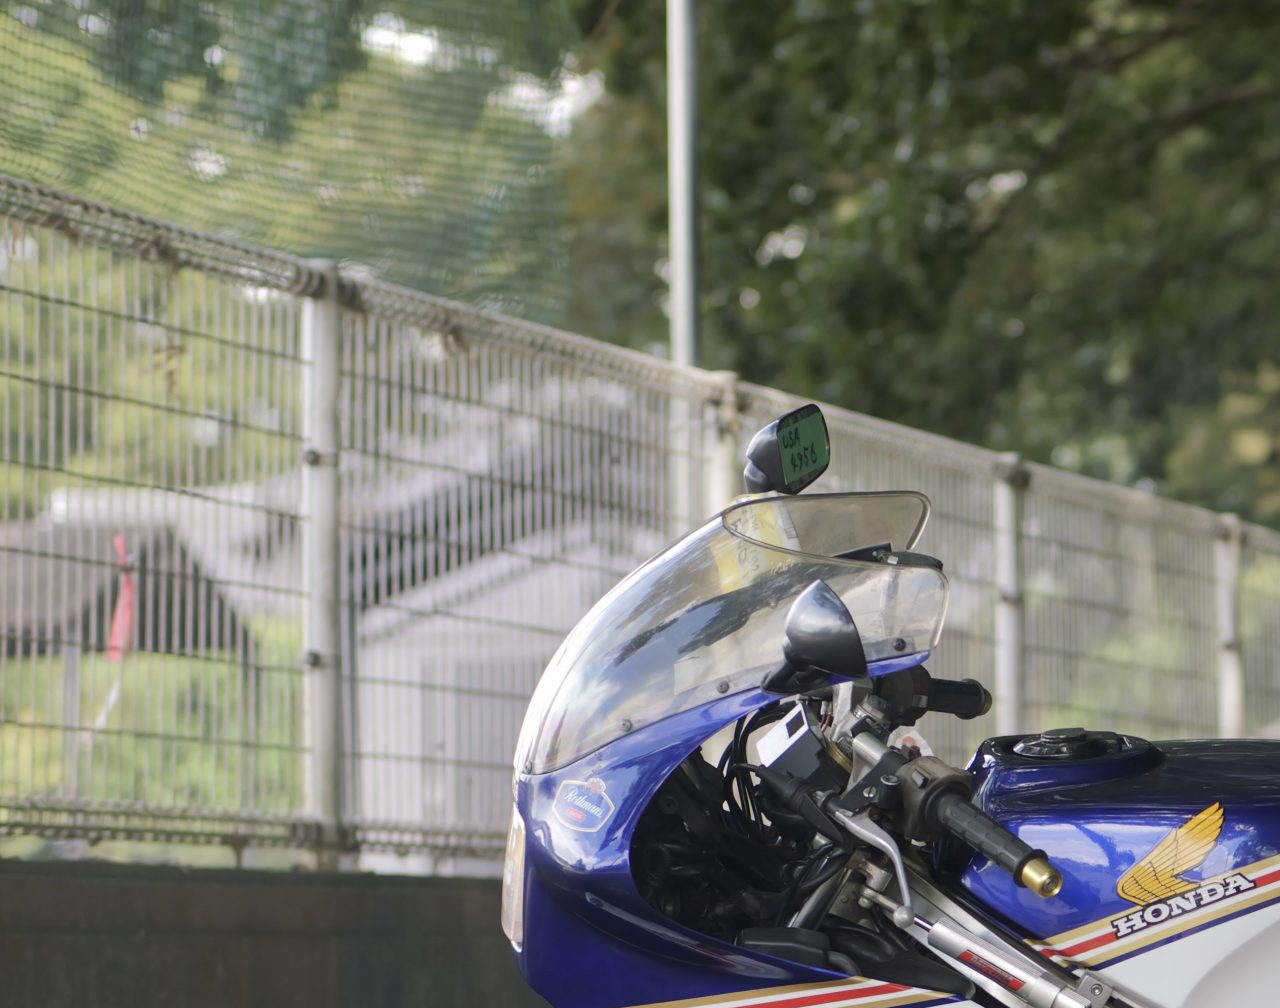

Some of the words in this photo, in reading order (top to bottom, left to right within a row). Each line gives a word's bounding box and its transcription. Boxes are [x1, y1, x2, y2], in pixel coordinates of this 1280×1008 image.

[782, 427, 800, 449] USA
[790, 442, 818, 473] 4956
[1112, 873, 1255, 938] HONDA
